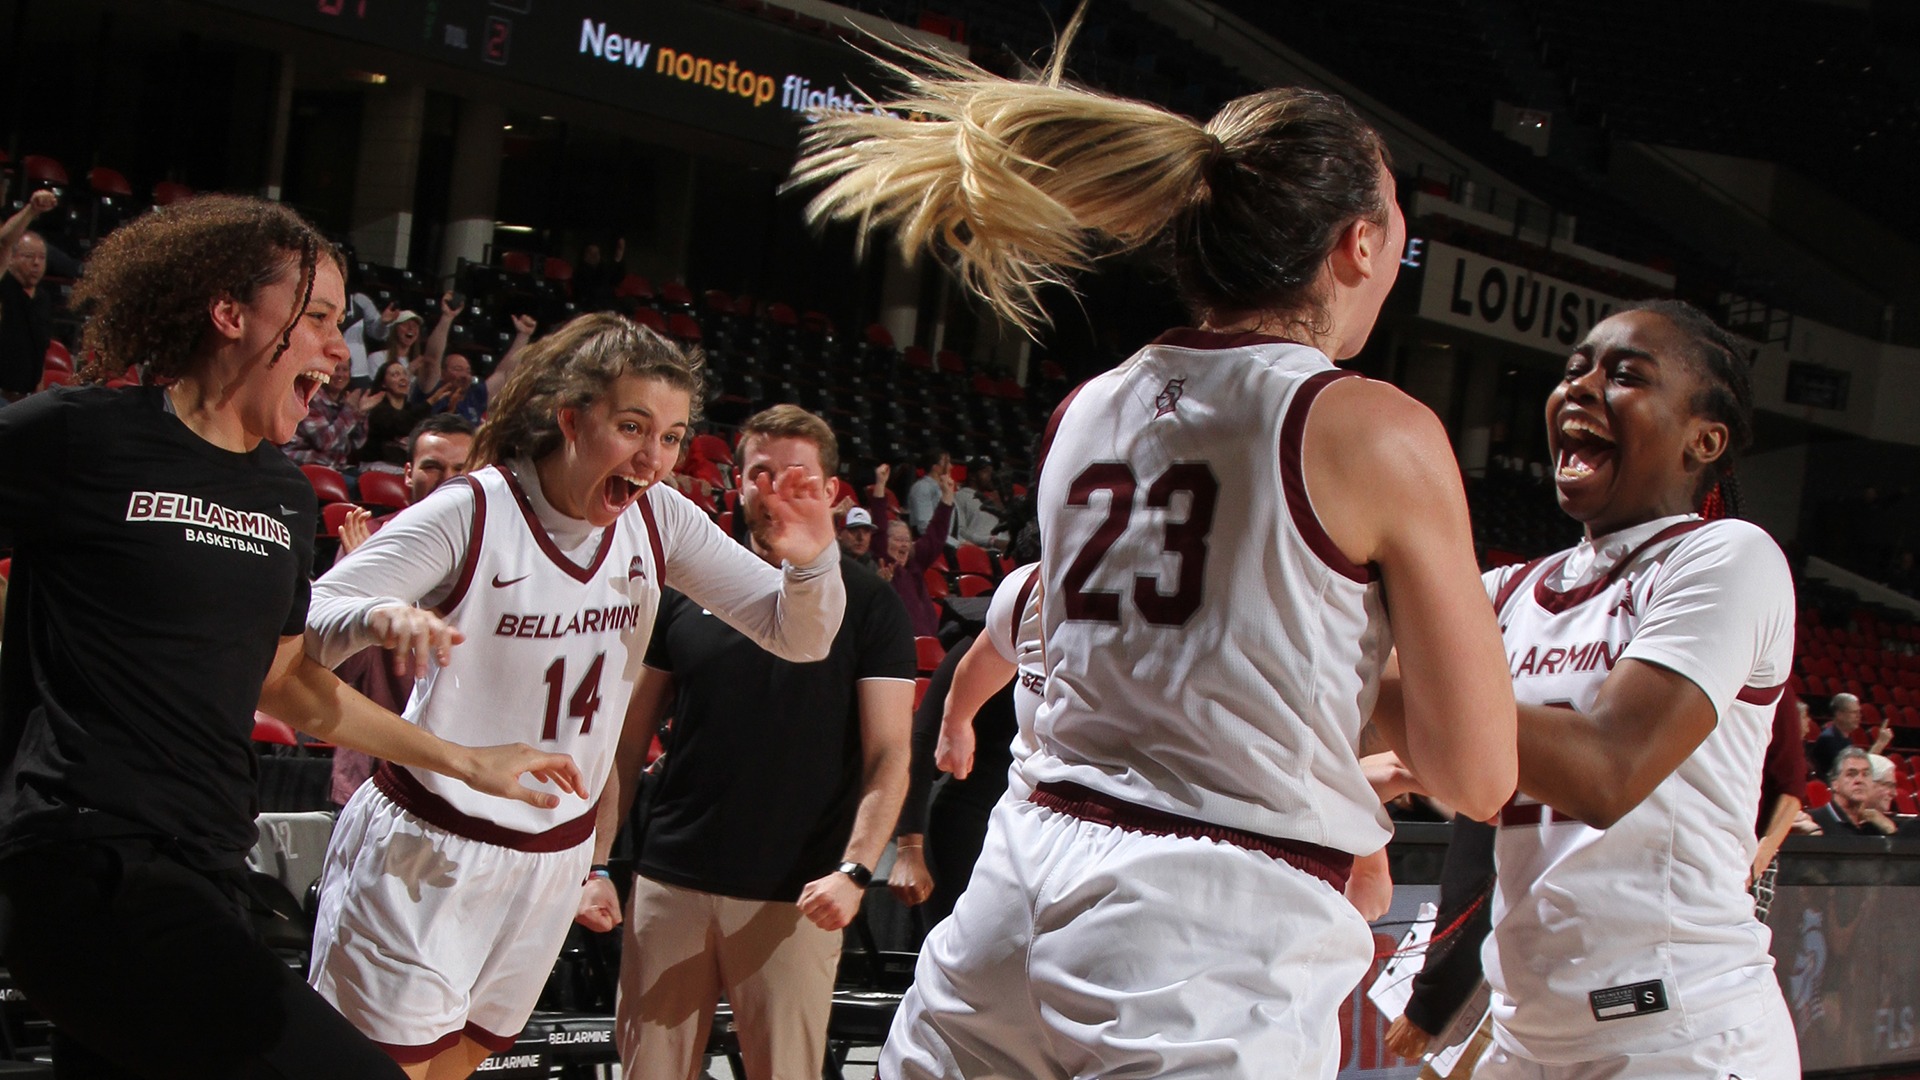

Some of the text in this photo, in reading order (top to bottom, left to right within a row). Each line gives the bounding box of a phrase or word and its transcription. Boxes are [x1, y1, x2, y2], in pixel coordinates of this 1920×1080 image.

[487, 23, 508, 57] 2
[580, 18, 650, 69] New
[656, 47, 776, 107] nonstop
[126, 491, 291, 550] BELLARMINE
[185, 528, 269, 556] BASKETBALL
[1063, 460, 1221, 630] 23
[541, 650, 608, 743] 14
[1644, 991, 1656, 1004] S
[549, 1031, 611, 1045] BELLARMINE
